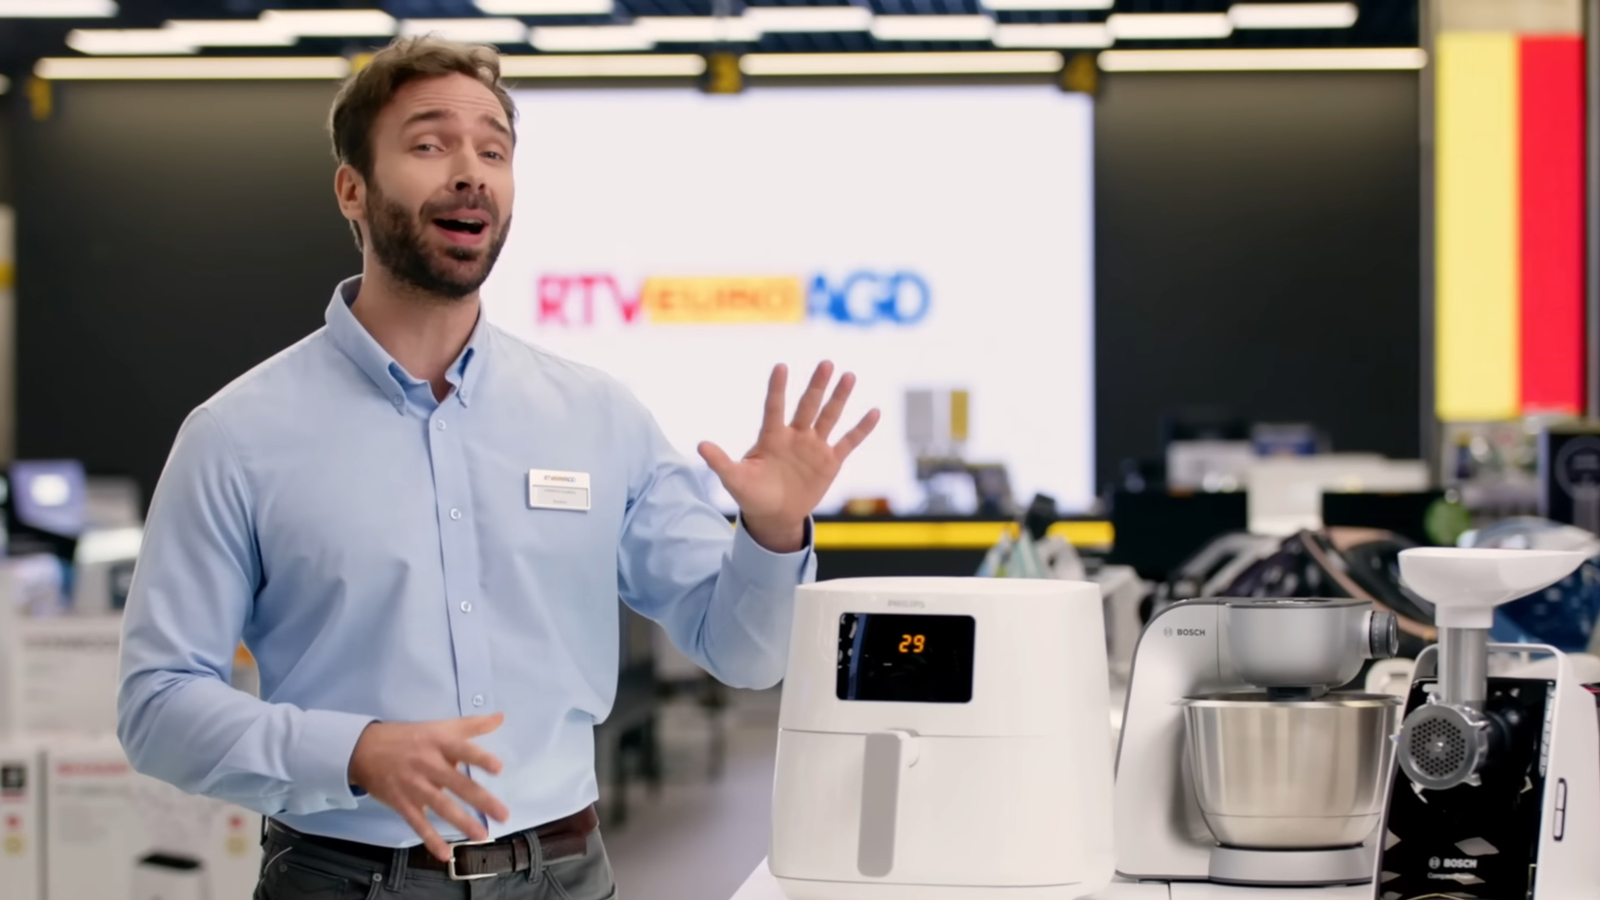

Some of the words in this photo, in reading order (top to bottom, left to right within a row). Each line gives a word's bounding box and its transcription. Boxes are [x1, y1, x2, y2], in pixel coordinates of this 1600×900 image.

[1176, 628, 1206, 637] BOSCH
[898, 633, 925, 653] 29
[1443, 858, 1478, 869] BOSCH
